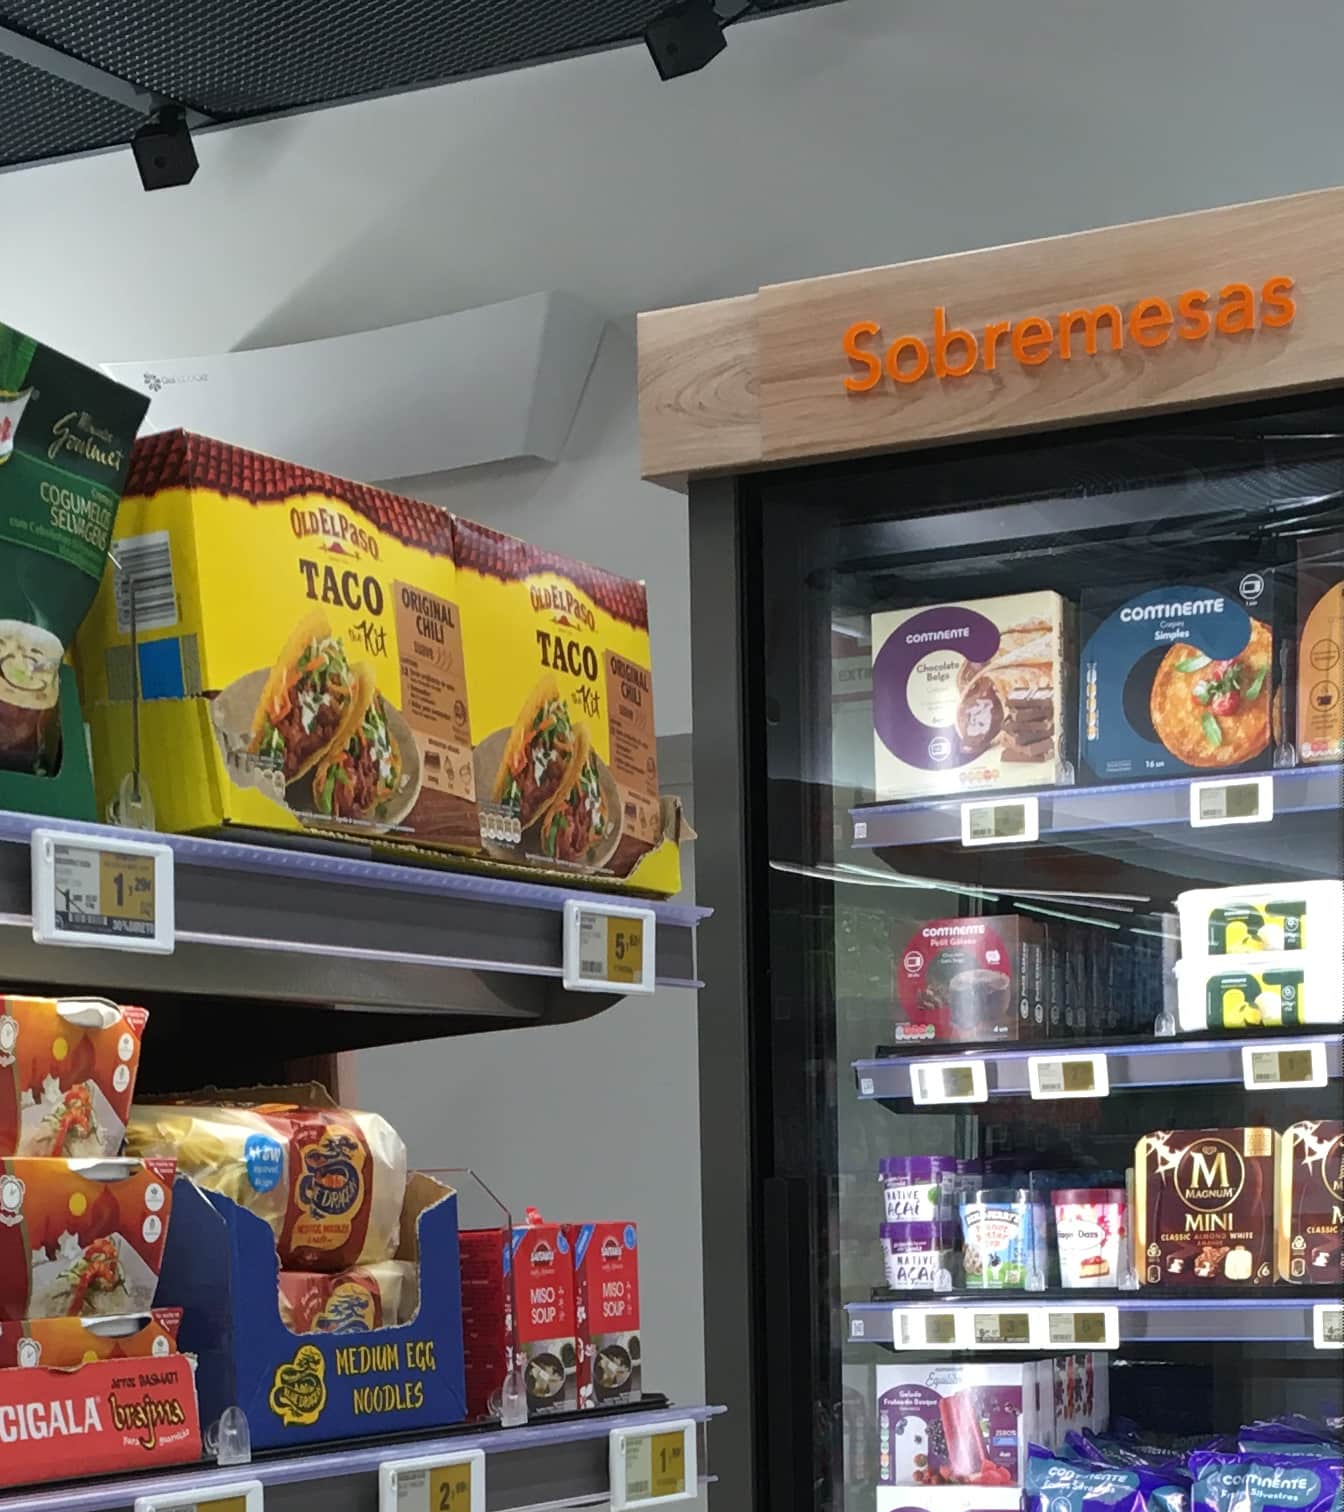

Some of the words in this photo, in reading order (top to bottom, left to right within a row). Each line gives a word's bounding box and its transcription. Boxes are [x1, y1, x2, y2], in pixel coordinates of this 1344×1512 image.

[842, 268, 1297, 394] Sobremesas
[300, 559, 383, 616] TACO
[402, 588, 454, 629] ORIGINAL
[1120, 599, 1224, 622] CONTINENTE
[355, 621, 387, 657] Kit
[416, 616, 444, 644] CHILI
[906, 627, 970, 644] CONTINENTE
[1154, 630, 1190, 641] Simples
[537, 631, 598, 682] TACO
[922, 925, 984, 937] CONTINENTE
[886, 1190, 919, 1202] NATIVE
[1186, 1189, 1233, 1199] MAGNUM
[1185, 1213, 1233, 1231] MINI
[1161, 1233, 1190, 1241] CLASSIC
[1230, 1231, 1253, 1239] WHITE
[530, 1289, 555, 1303] MISO
[603, 1283, 623, 1297] MISO
[531, 1307, 556, 1324] SOUP
[603, 1302, 624, 1317] SOUP
[336, 1344, 399, 1375] MEDIUM
[408, 1342, 435, 1370] EGG
[354, 1382, 424, 1415] NOODLES
[109, 1394, 184, 1448] brajma
